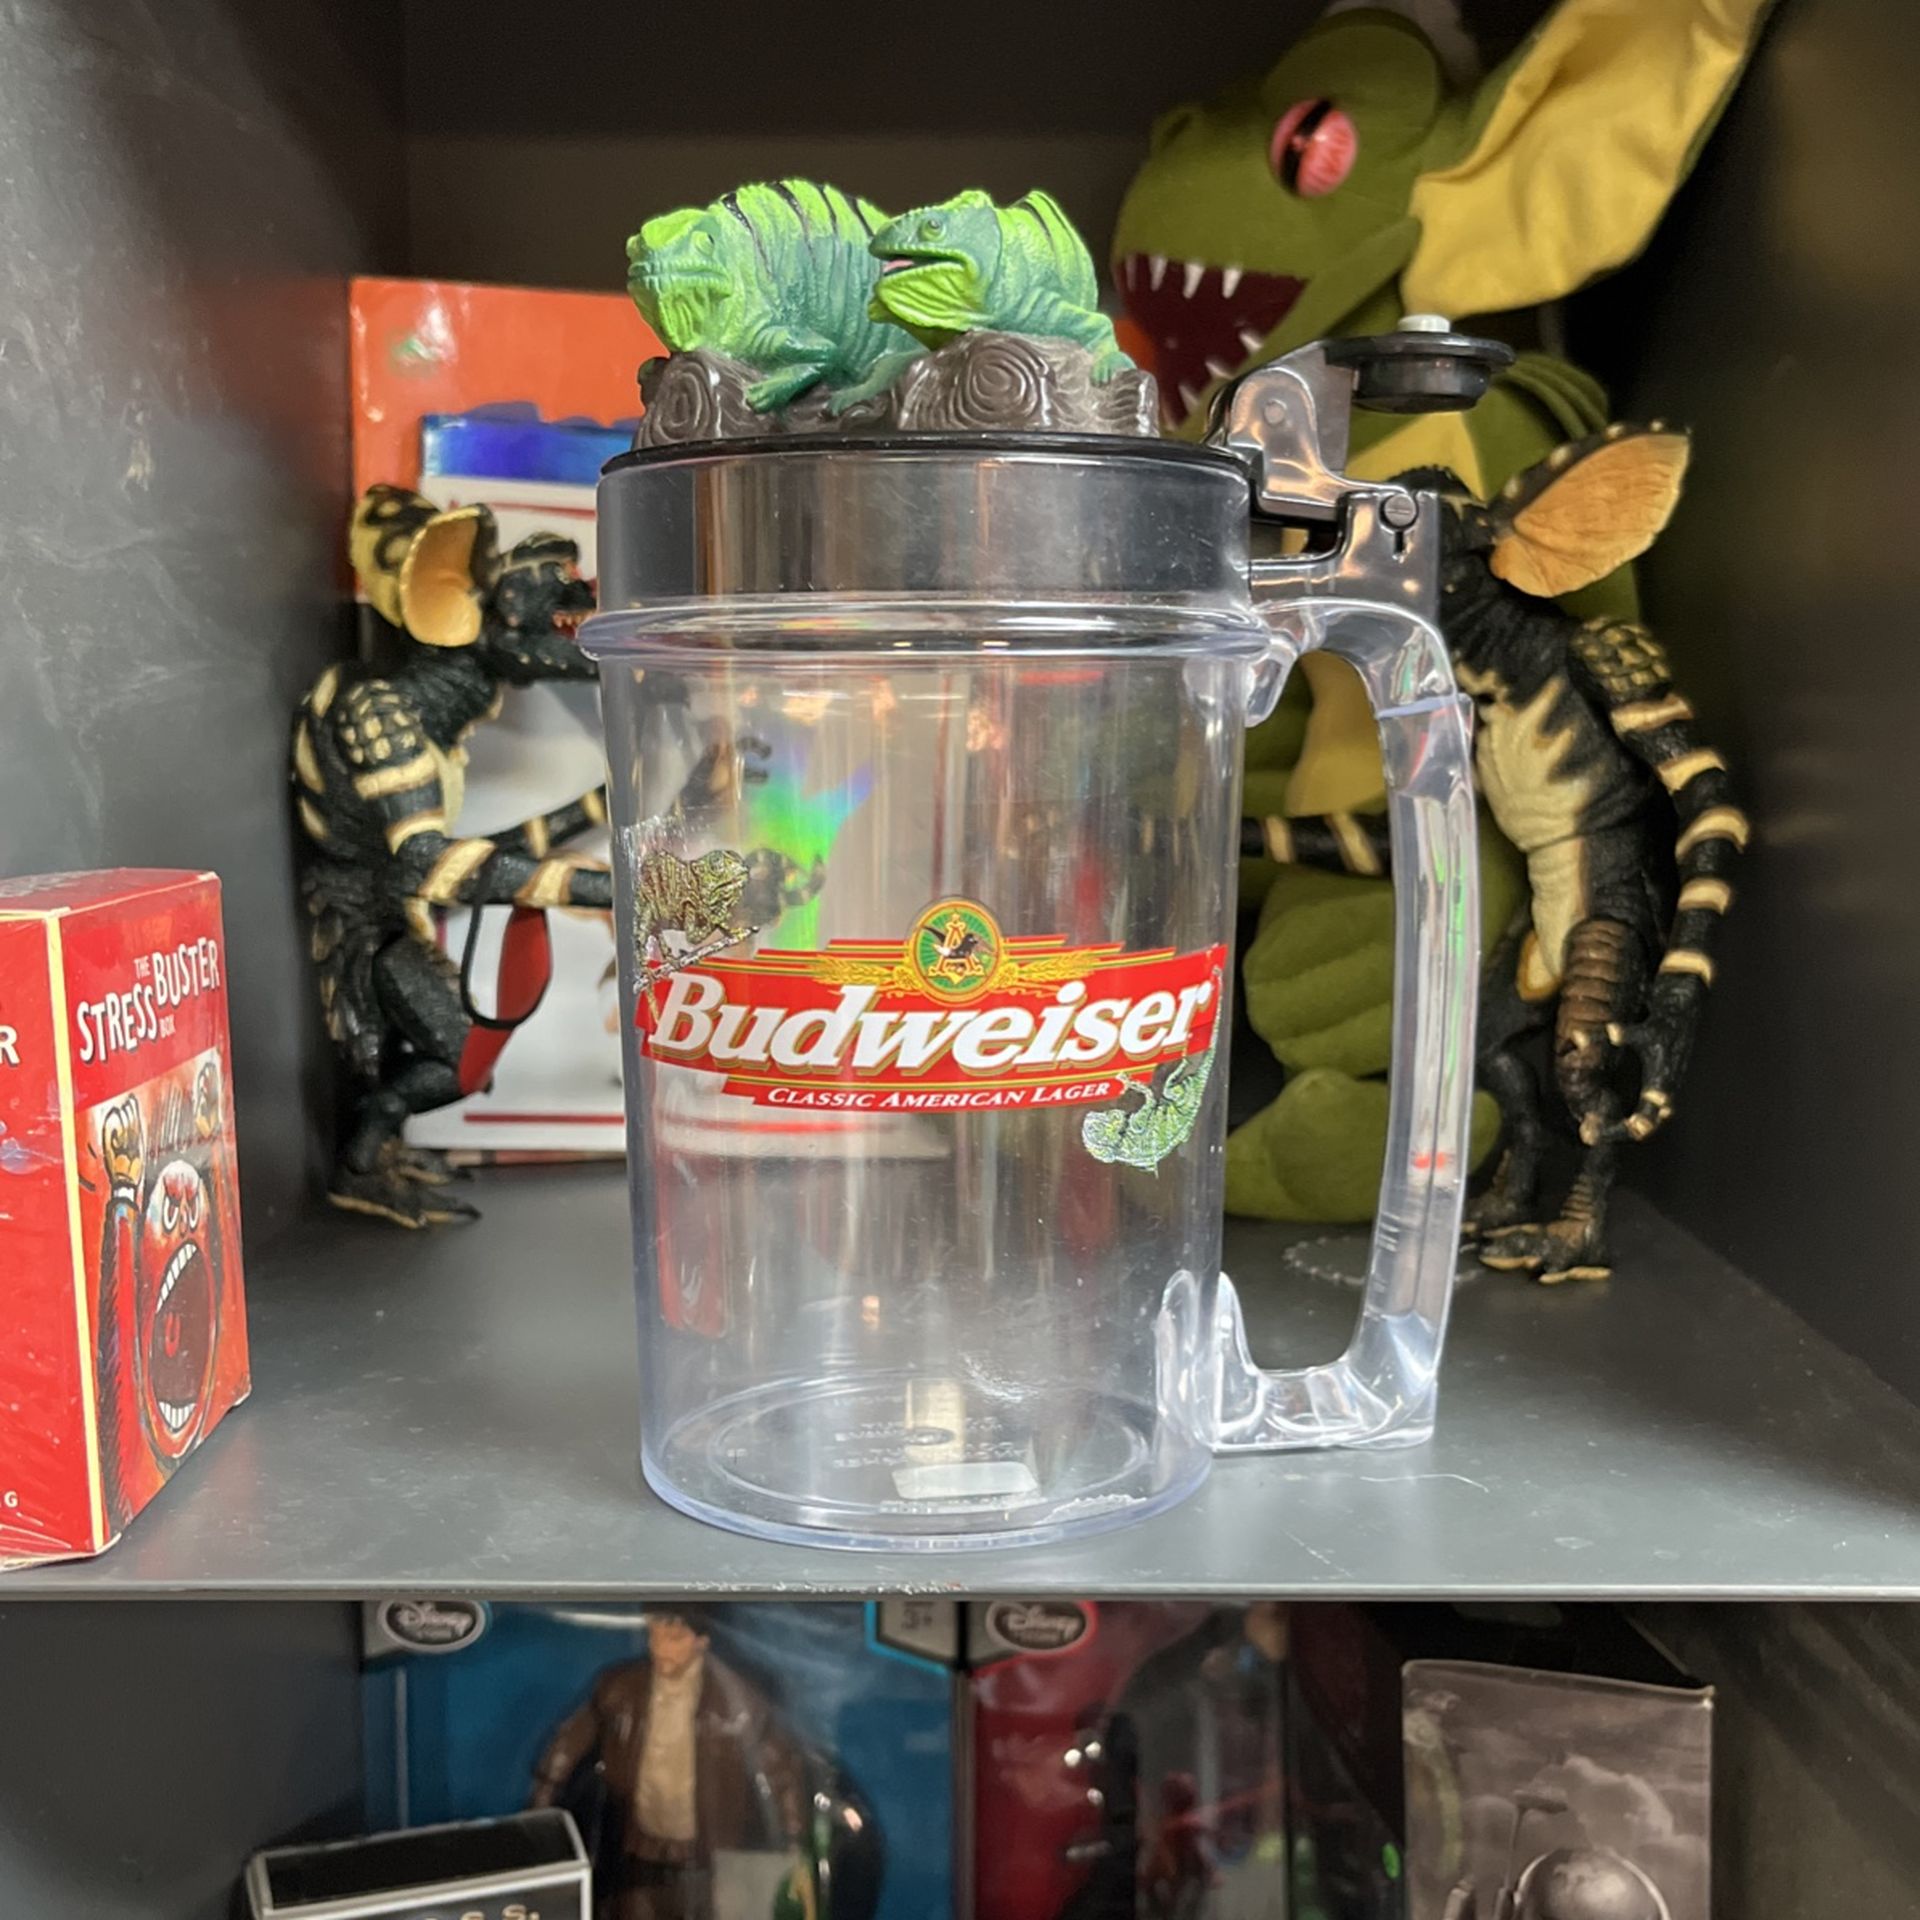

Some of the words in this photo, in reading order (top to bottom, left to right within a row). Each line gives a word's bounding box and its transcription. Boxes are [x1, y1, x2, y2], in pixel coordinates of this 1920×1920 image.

[134, 956, 151, 978] THE
[152, 937, 220, 1007] BUSTER
[76, 983, 159, 1062] STRESS
[159, 1014, 176, 1039] BOX
[648, 971, 1213, 1070] Budweiser
[767, 1086, 876, 1108] CLASSIC
[879, 1086, 1026, 1109] AMERICAN
[1029, 1081, 1111, 1104] LAGER
